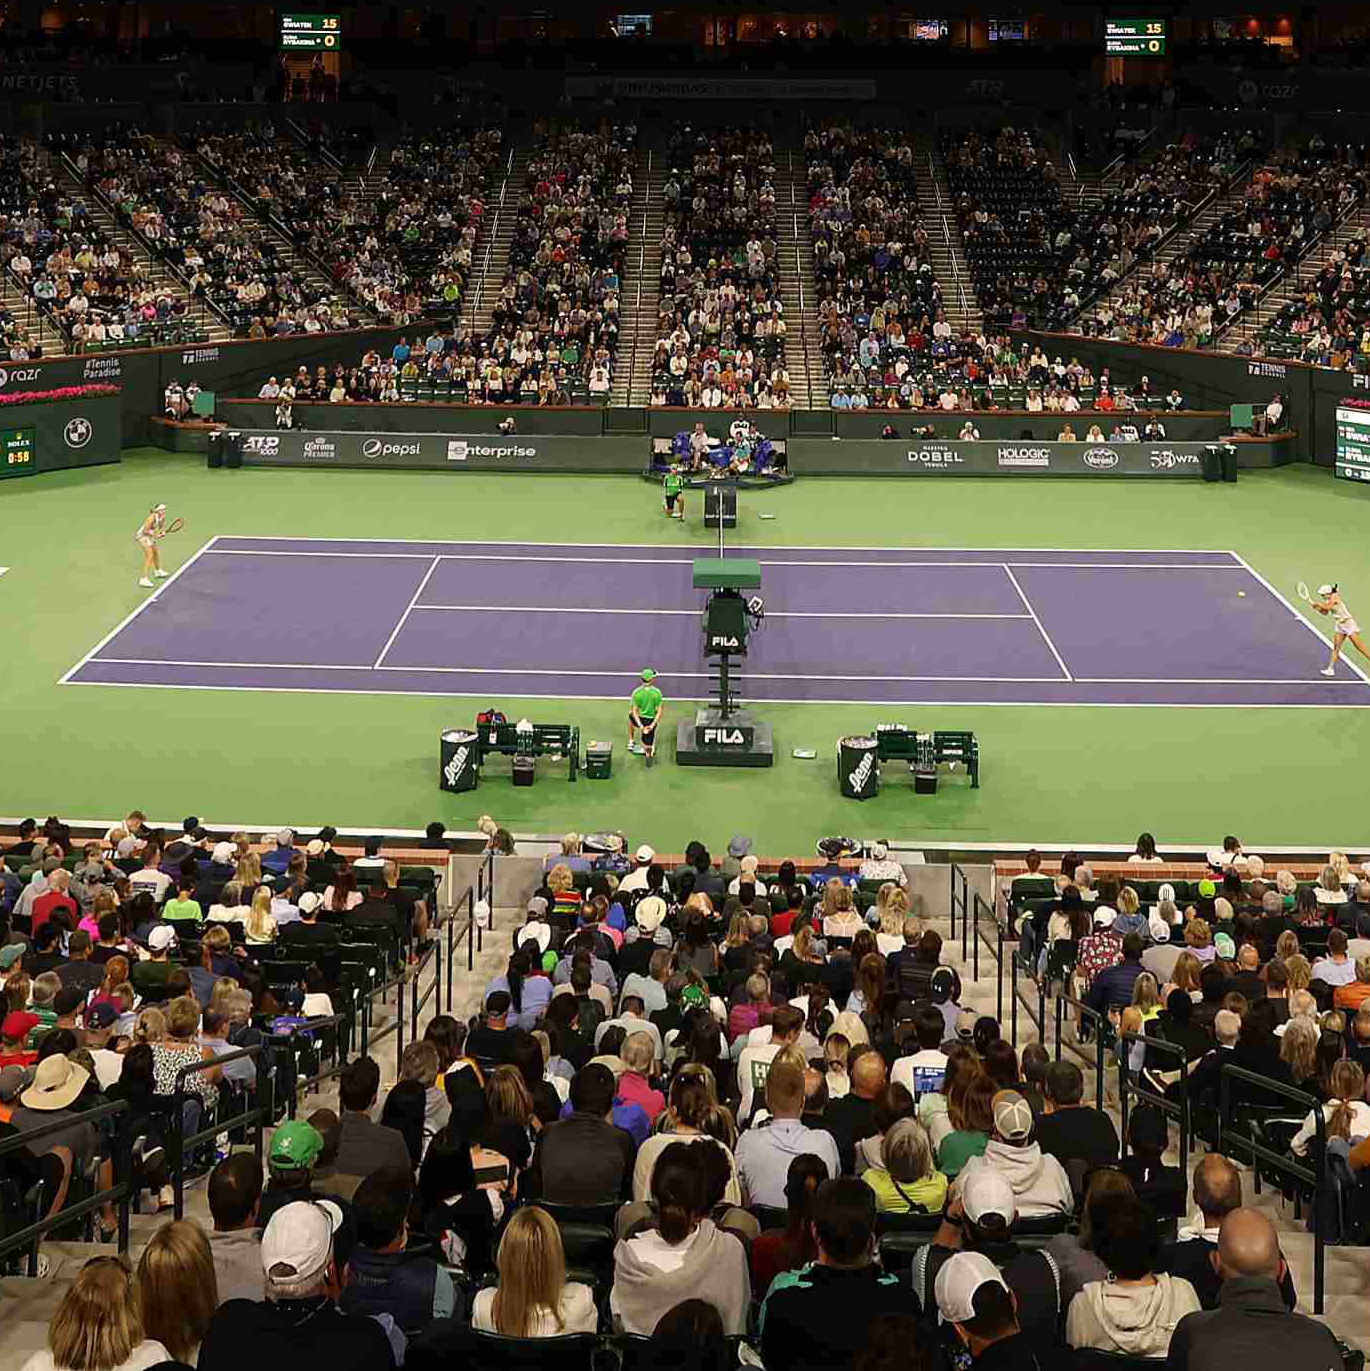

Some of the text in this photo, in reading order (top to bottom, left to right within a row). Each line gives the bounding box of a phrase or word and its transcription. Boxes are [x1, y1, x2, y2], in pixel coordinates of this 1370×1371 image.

[323, 18, 337, 28] 15
[1146, 23, 1162, 34] 15
[324, 35, 334, 46] 0
[1148, 40, 1160, 52] 0
[11, 368, 42, 382] razr
[243, 436, 279, 449] ATP
[382, 442, 422, 456] pepsi
[454, 443, 536, 458] enterprise
[997, 448, 1050, 459] HOLOGIC
[8, 450, 30, 464] 0:58
[908, 451, 965, 462] DOBEL
[1176, 454, 1200, 463] WTA
[712, 636, 739, 647] FILA
[704, 728, 745, 744] FILA
